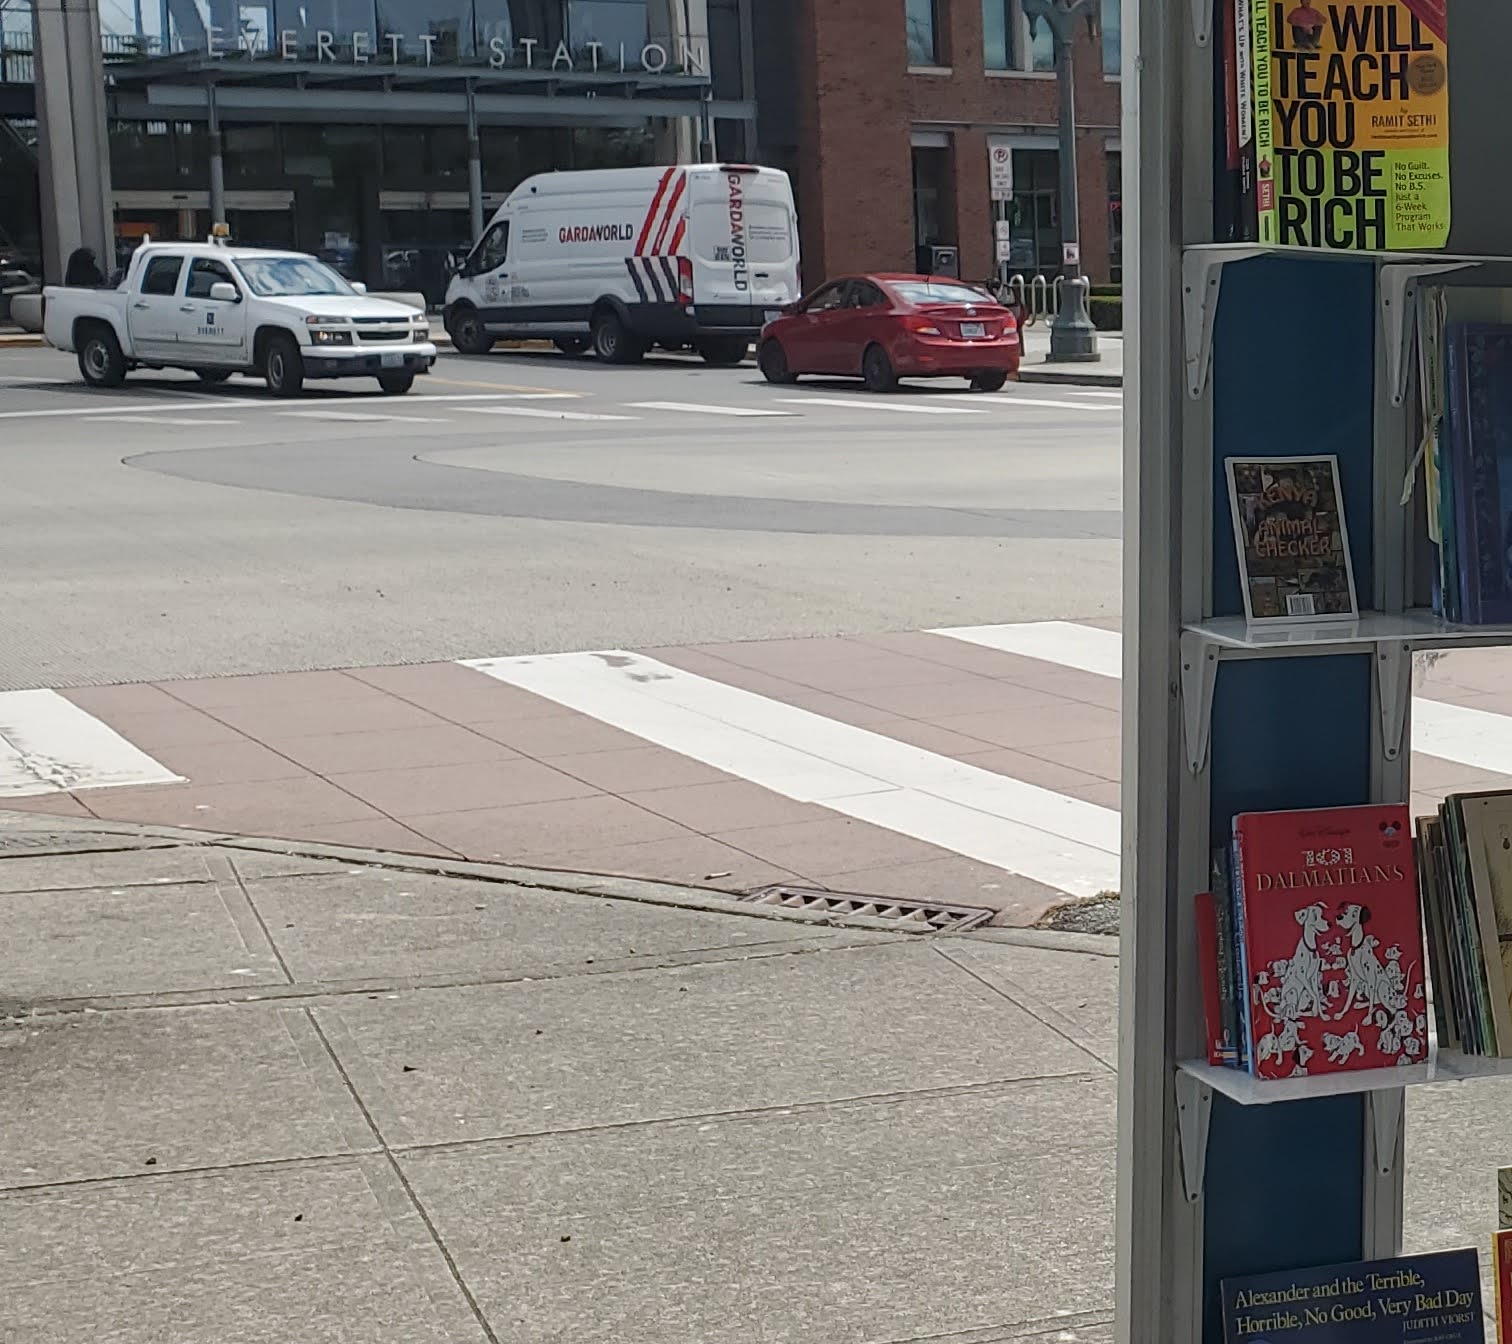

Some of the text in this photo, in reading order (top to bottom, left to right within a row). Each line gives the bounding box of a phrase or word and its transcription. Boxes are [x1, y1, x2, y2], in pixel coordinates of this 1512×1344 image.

[1255, 16, 1267, 51] TEACH
[1275, 3, 1284, 49] I
[1328, 5, 1434, 52] WILL
[207, 26, 705, 74] EVERETT STATION
[1257, 54, 1268, 81] YOU
[1272, 51, 1409, 100] TEACH
[1258, 83, 1269, 96] TO
[1258, 100, 1269, 117] BE
[1259, 117, 1270, 148] RICH
[1273, 101, 1355, 148] YOU
[1371, 114, 1437, 128] RAMIT SETHI
[1274, 148, 1324, 196] TO
[1333, 150, 1387, 197] BE
[1394, 162, 1406, 170] No
[1394, 172, 1406, 180] No
[1395, 182, 1406, 190] No
[1395, 192, 1411, 201] Just
[1278, 196, 1386, 250] RICH
[1395, 212, 1431, 222] Program
[1396, 222, 1443, 231] That Works
[559, 224, 634, 244] GARDAWORLD
[728, 174, 748, 292] GARDAWORLD
[1258, 483, 1318, 509] KENYA
[1259, 518, 1324, 536] ANIMAL
[1255, 537, 1332, 557] CHECKER
[1301, 847, 1352, 866] 101
[1257, 864, 1405, 891] DALMATIANS
[1236, 1269, 1425, 1309] Alexander and the Terrible,
[1236, 1289, 1474, 1335] Horrible, No Good, Very Bad Day
[1403, 1312, 1474, 1332] JUDITH VIORST
